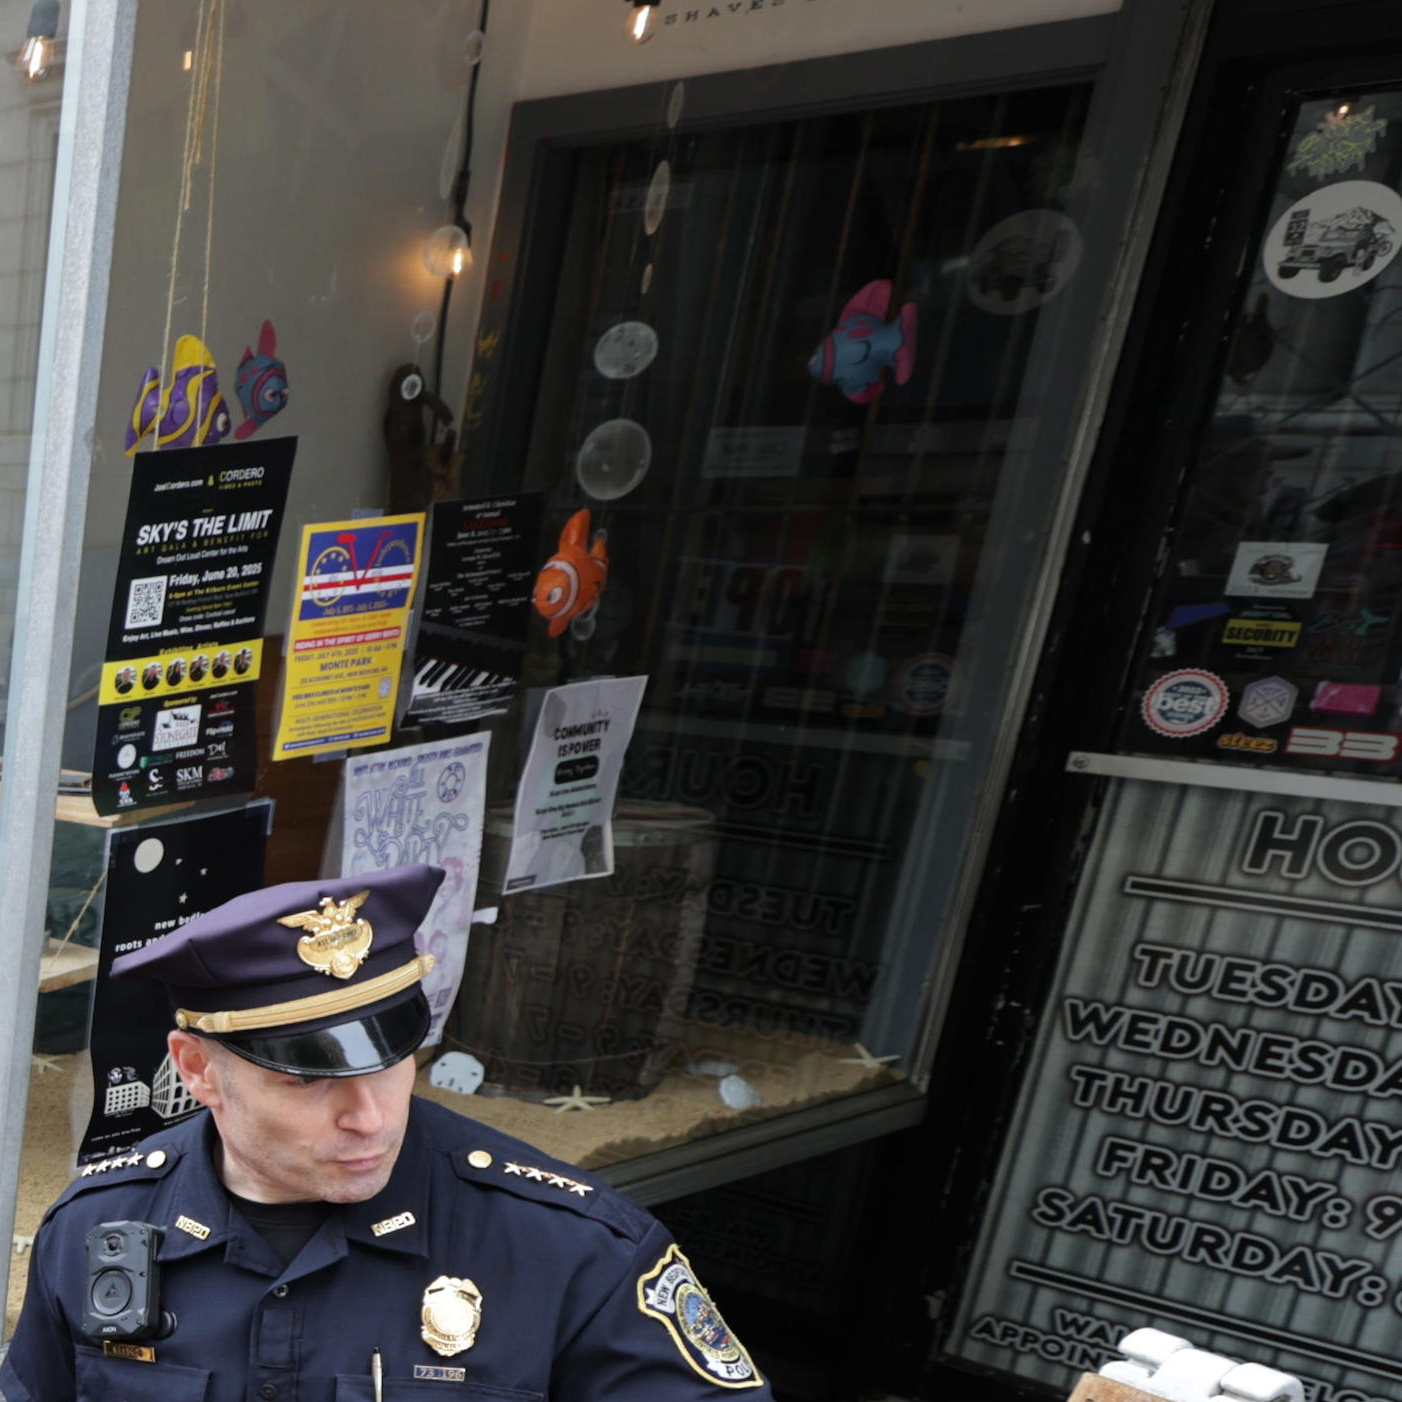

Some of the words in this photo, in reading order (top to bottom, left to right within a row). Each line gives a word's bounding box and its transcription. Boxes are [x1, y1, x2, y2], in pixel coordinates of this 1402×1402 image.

[220, 467, 264, 482] CORDERO
[137, 520, 189, 545] SKY'S
[192, 514, 227, 537] THE
[227, 509, 273, 533] LIMIT
[136, 546, 155, 555] ART
[162, 543, 186, 552] GALA
[204, 534, 245, 546] BENEFIT
[251, 531, 269, 540] FOR
[169, 572, 200, 587] Friday,
[202, 569, 225, 582] June
[241, 562, 263, 576] 2025
[1227, 626, 1297, 644] SECURITY
[320, 658, 350, 672] MONTE
[351, 656, 373, 669] PARK
[1157, 694, 1218, 718] best
[554, 719, 611, 741] COMMUNITY
[557, 744, 569, 758] IS
[569, 738, 602, 755] POWER
[1286, 726, 1400, 761] 33
[176, 765, 203, 783] SKM
[155, 919, 176, 930] new
[115, 938, 143, 952] roots
[1097, 1137, 1351, 1230] FRIDAY:
[1034, 1187, 1386, 1306] SATURDAY:
[657, 1284, 670, 1306] NEW
